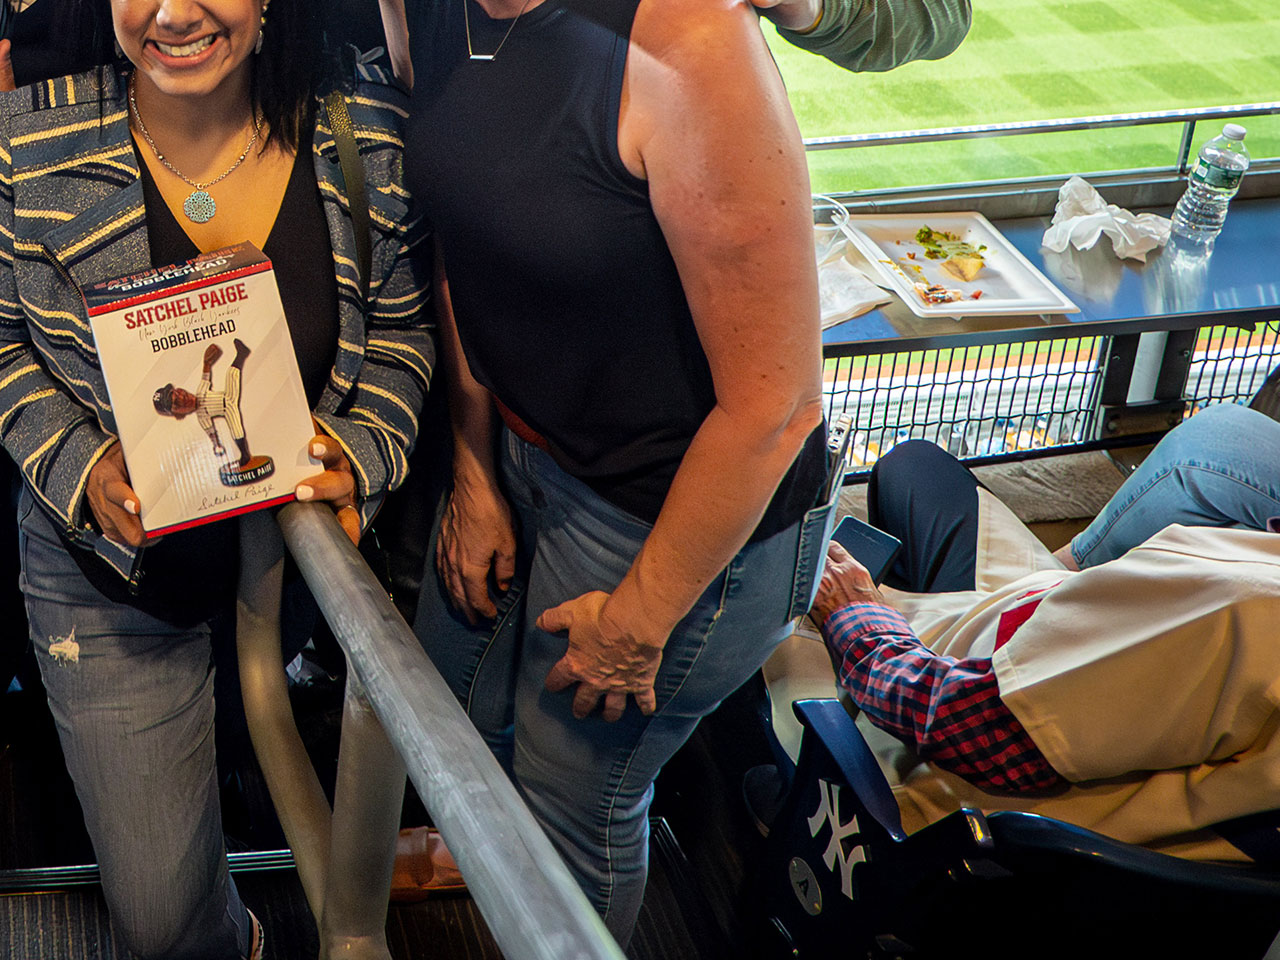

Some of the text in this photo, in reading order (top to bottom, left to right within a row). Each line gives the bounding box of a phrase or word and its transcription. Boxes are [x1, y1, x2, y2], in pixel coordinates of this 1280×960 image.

[121, 258, 228, 291] BOBBLEHEAD
[124, 283, 248, 330] SATCHEL PAIGE
[151, 319, 237, 353] BOBBLEHEAD
